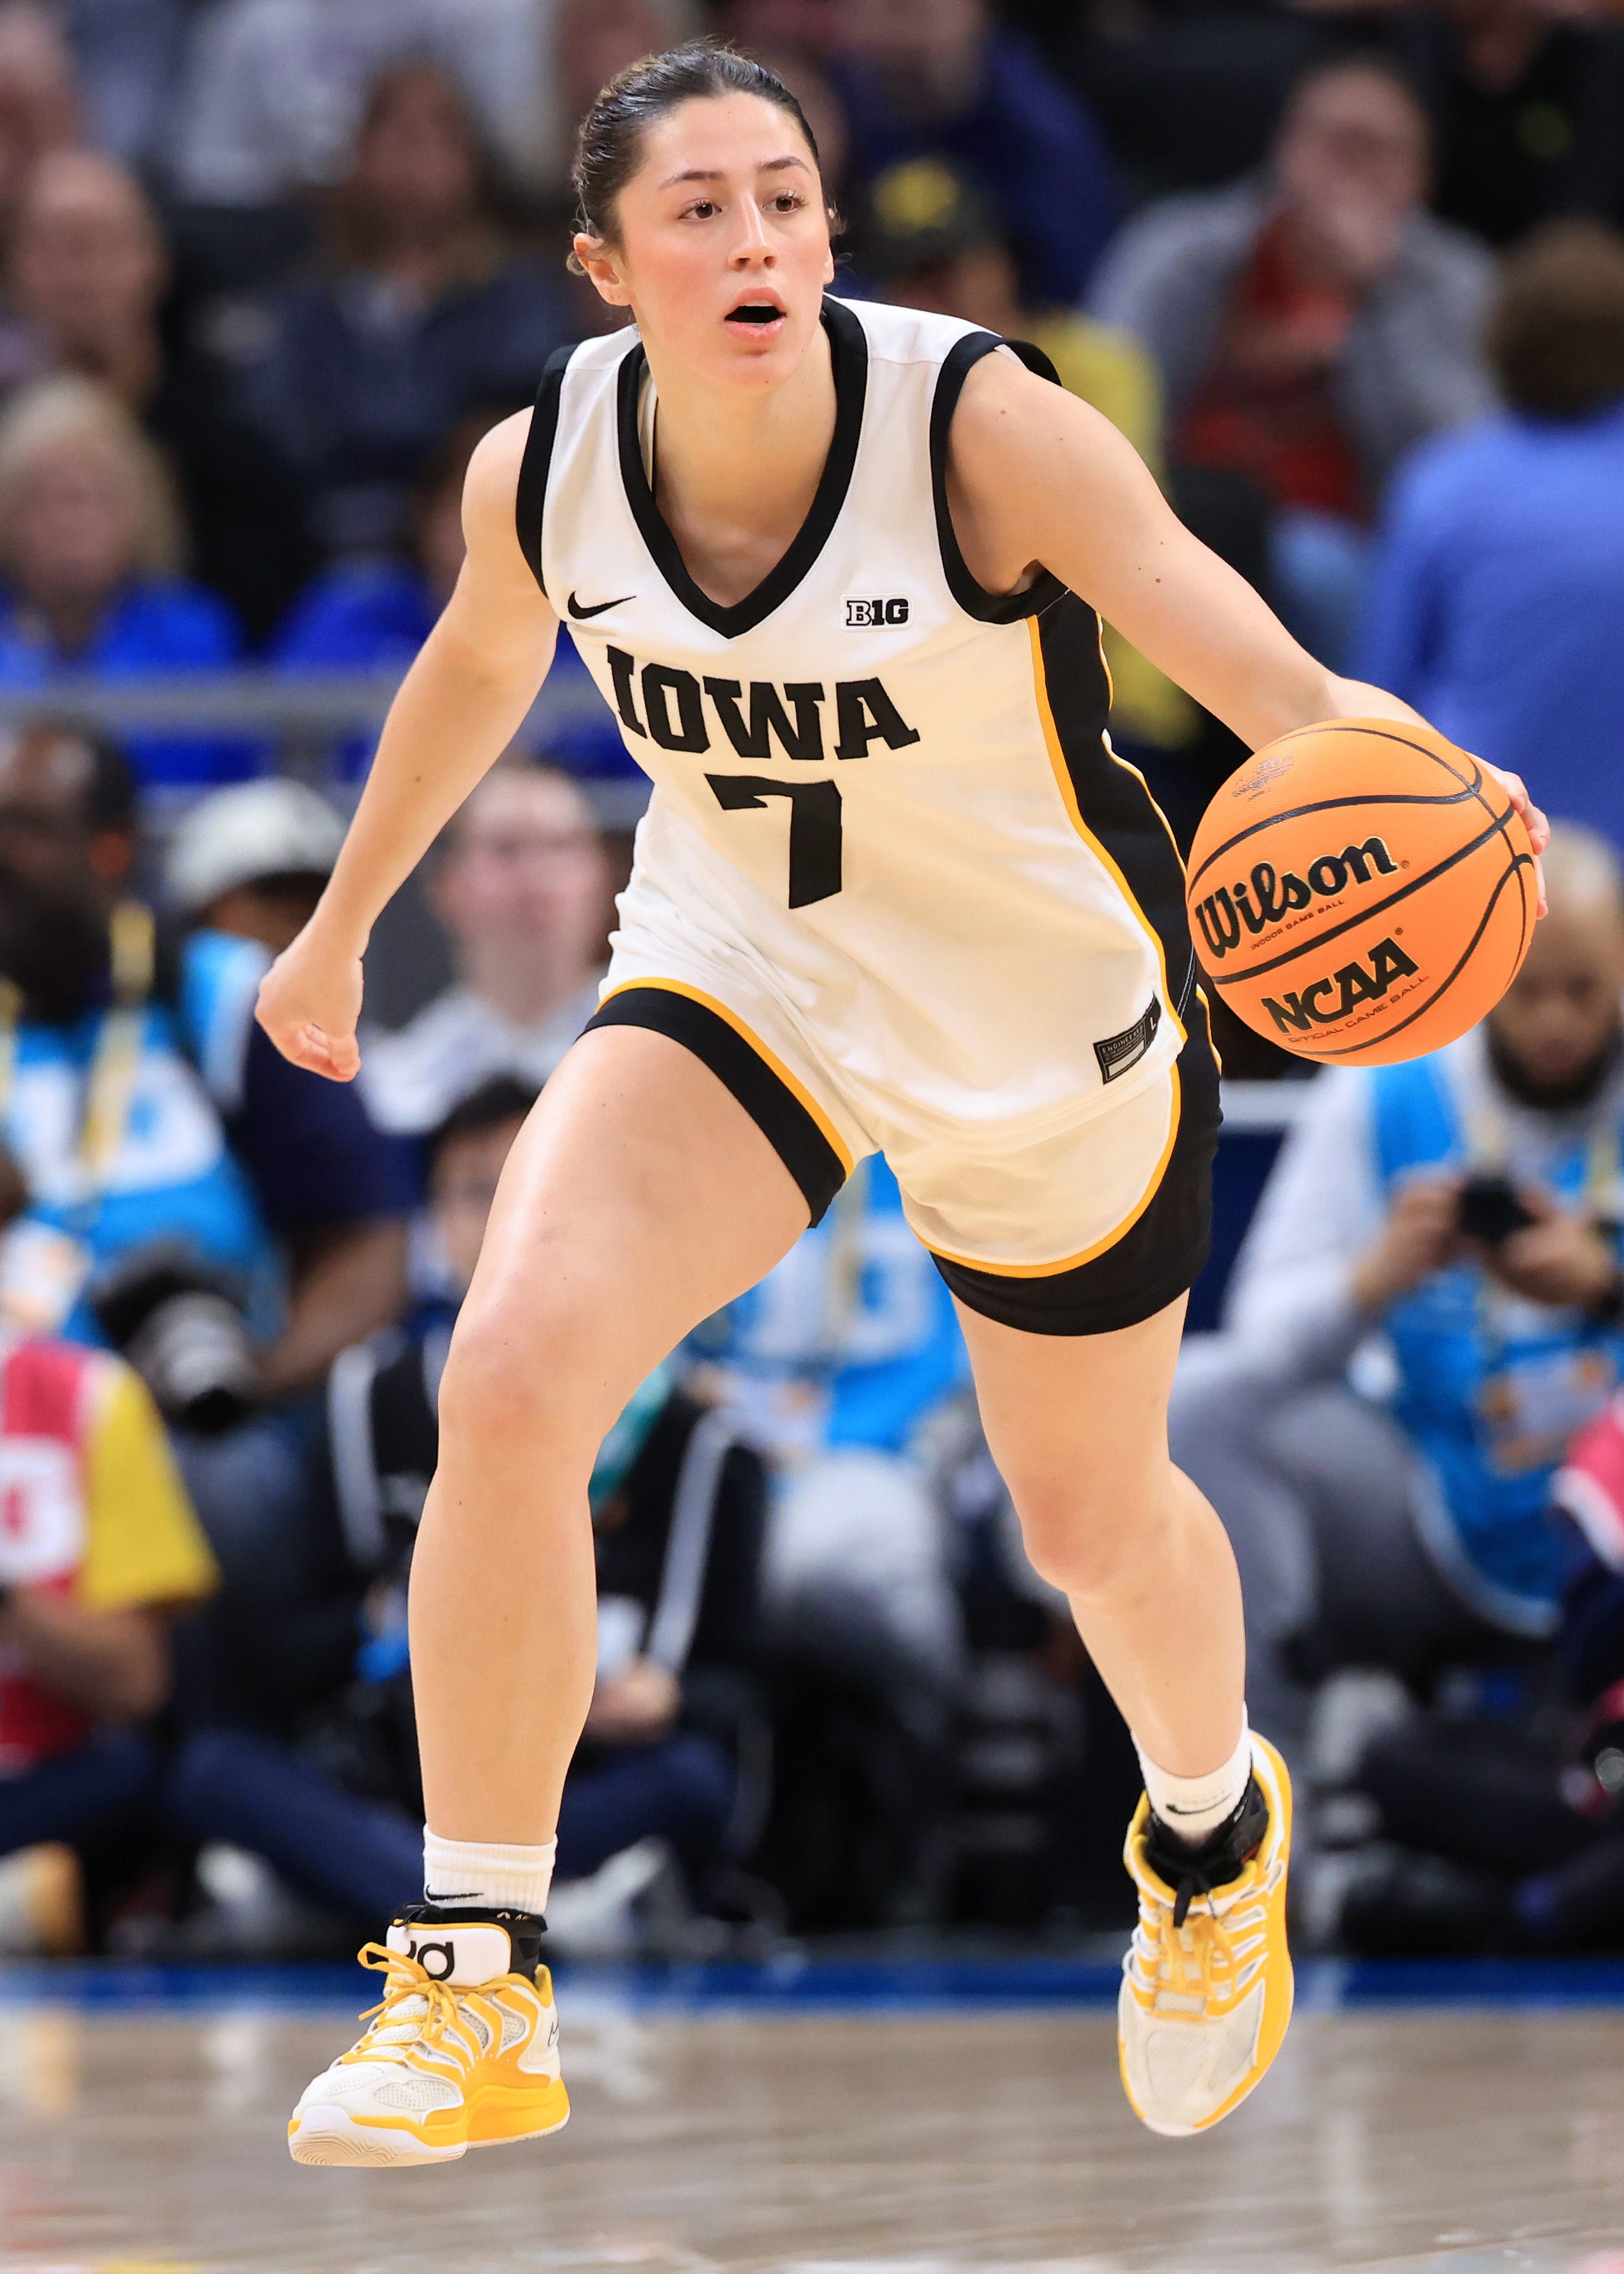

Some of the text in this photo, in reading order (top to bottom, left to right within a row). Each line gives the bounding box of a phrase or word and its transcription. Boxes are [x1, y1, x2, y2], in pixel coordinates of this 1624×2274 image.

[606, 644, 921, 760] IOWA
[704, 773, 843, 910] 7
[1195, 835, 1399, 959] Wilson
[1250, 900, 1344, 951] INDOOR GAME BALL
[1260, 936, 1421, 1033] NCAA
[1345, 1003, 1388, 1028] GAME
[1390, 976, 1429, 1004] BALL
